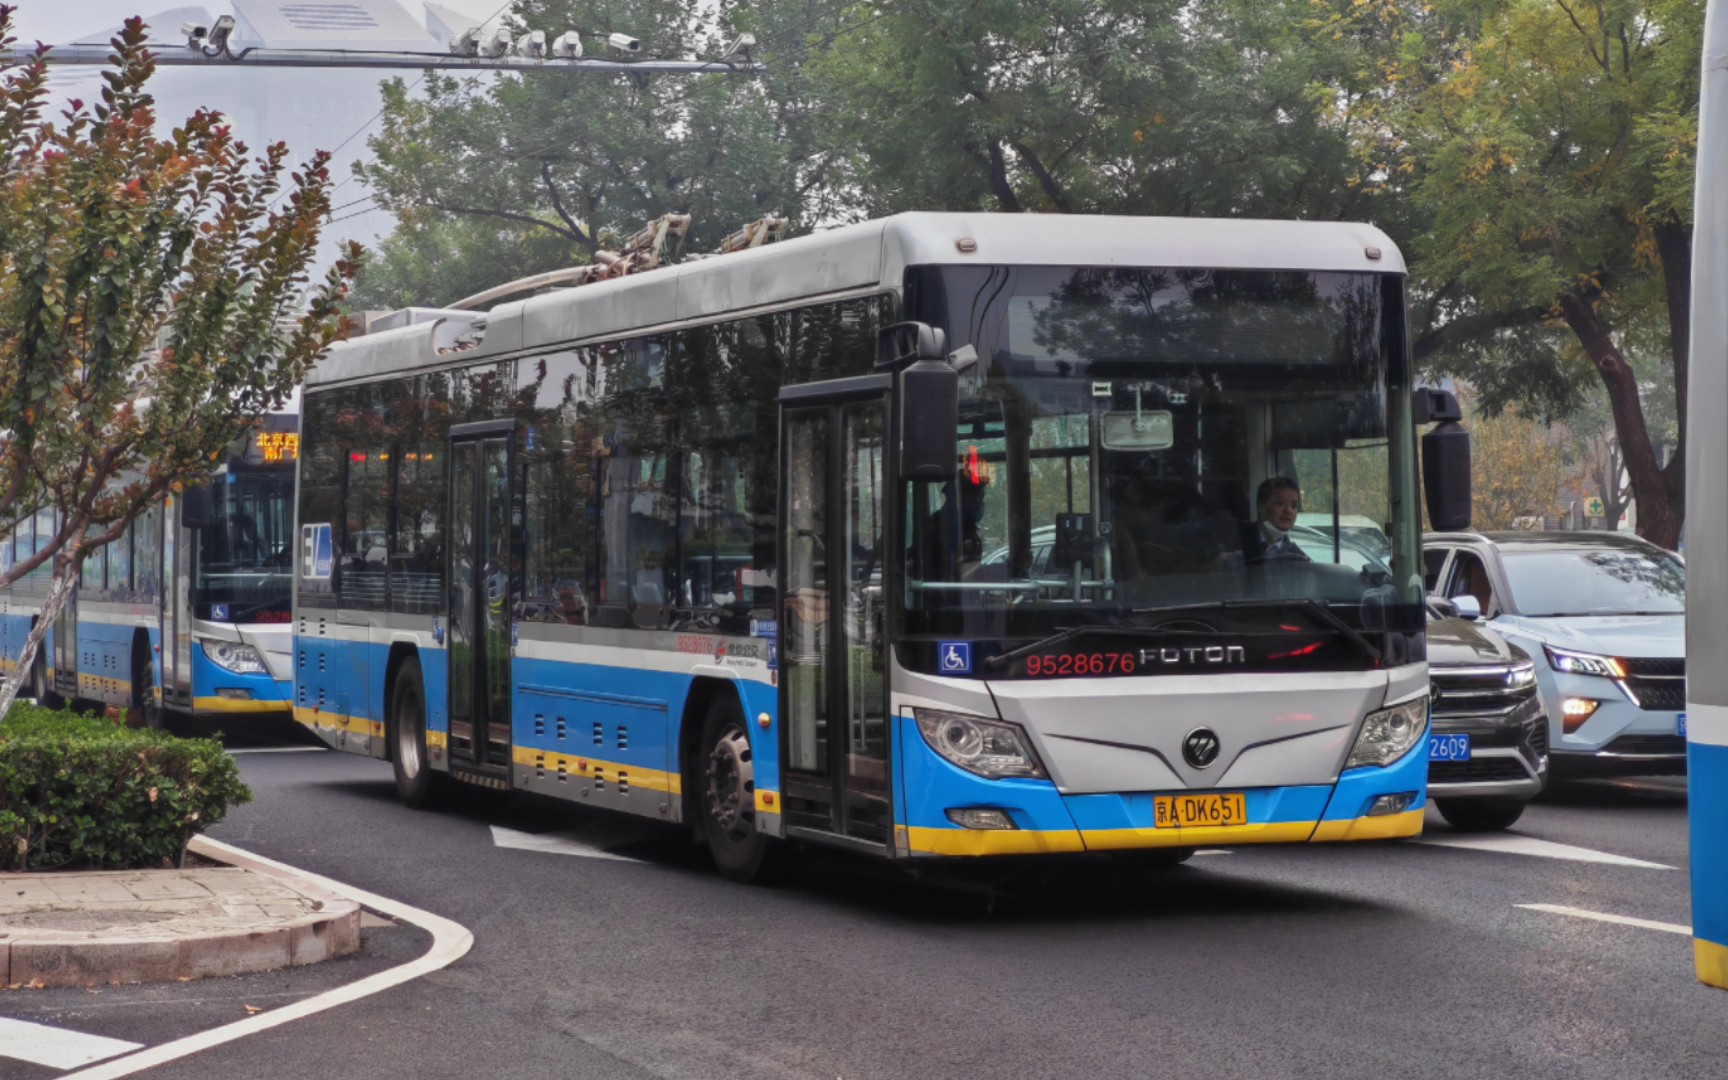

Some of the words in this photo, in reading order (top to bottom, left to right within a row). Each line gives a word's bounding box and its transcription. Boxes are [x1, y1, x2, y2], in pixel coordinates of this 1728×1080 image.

[678, 635, 713, 655] 9528676
[728, 643, 759, 659] 北京公交
[1139, 645, 1246, 665] FOTON
[1026, 653, 1135, 675] 9528676
[1430, 738, 1468, 757] 2609
